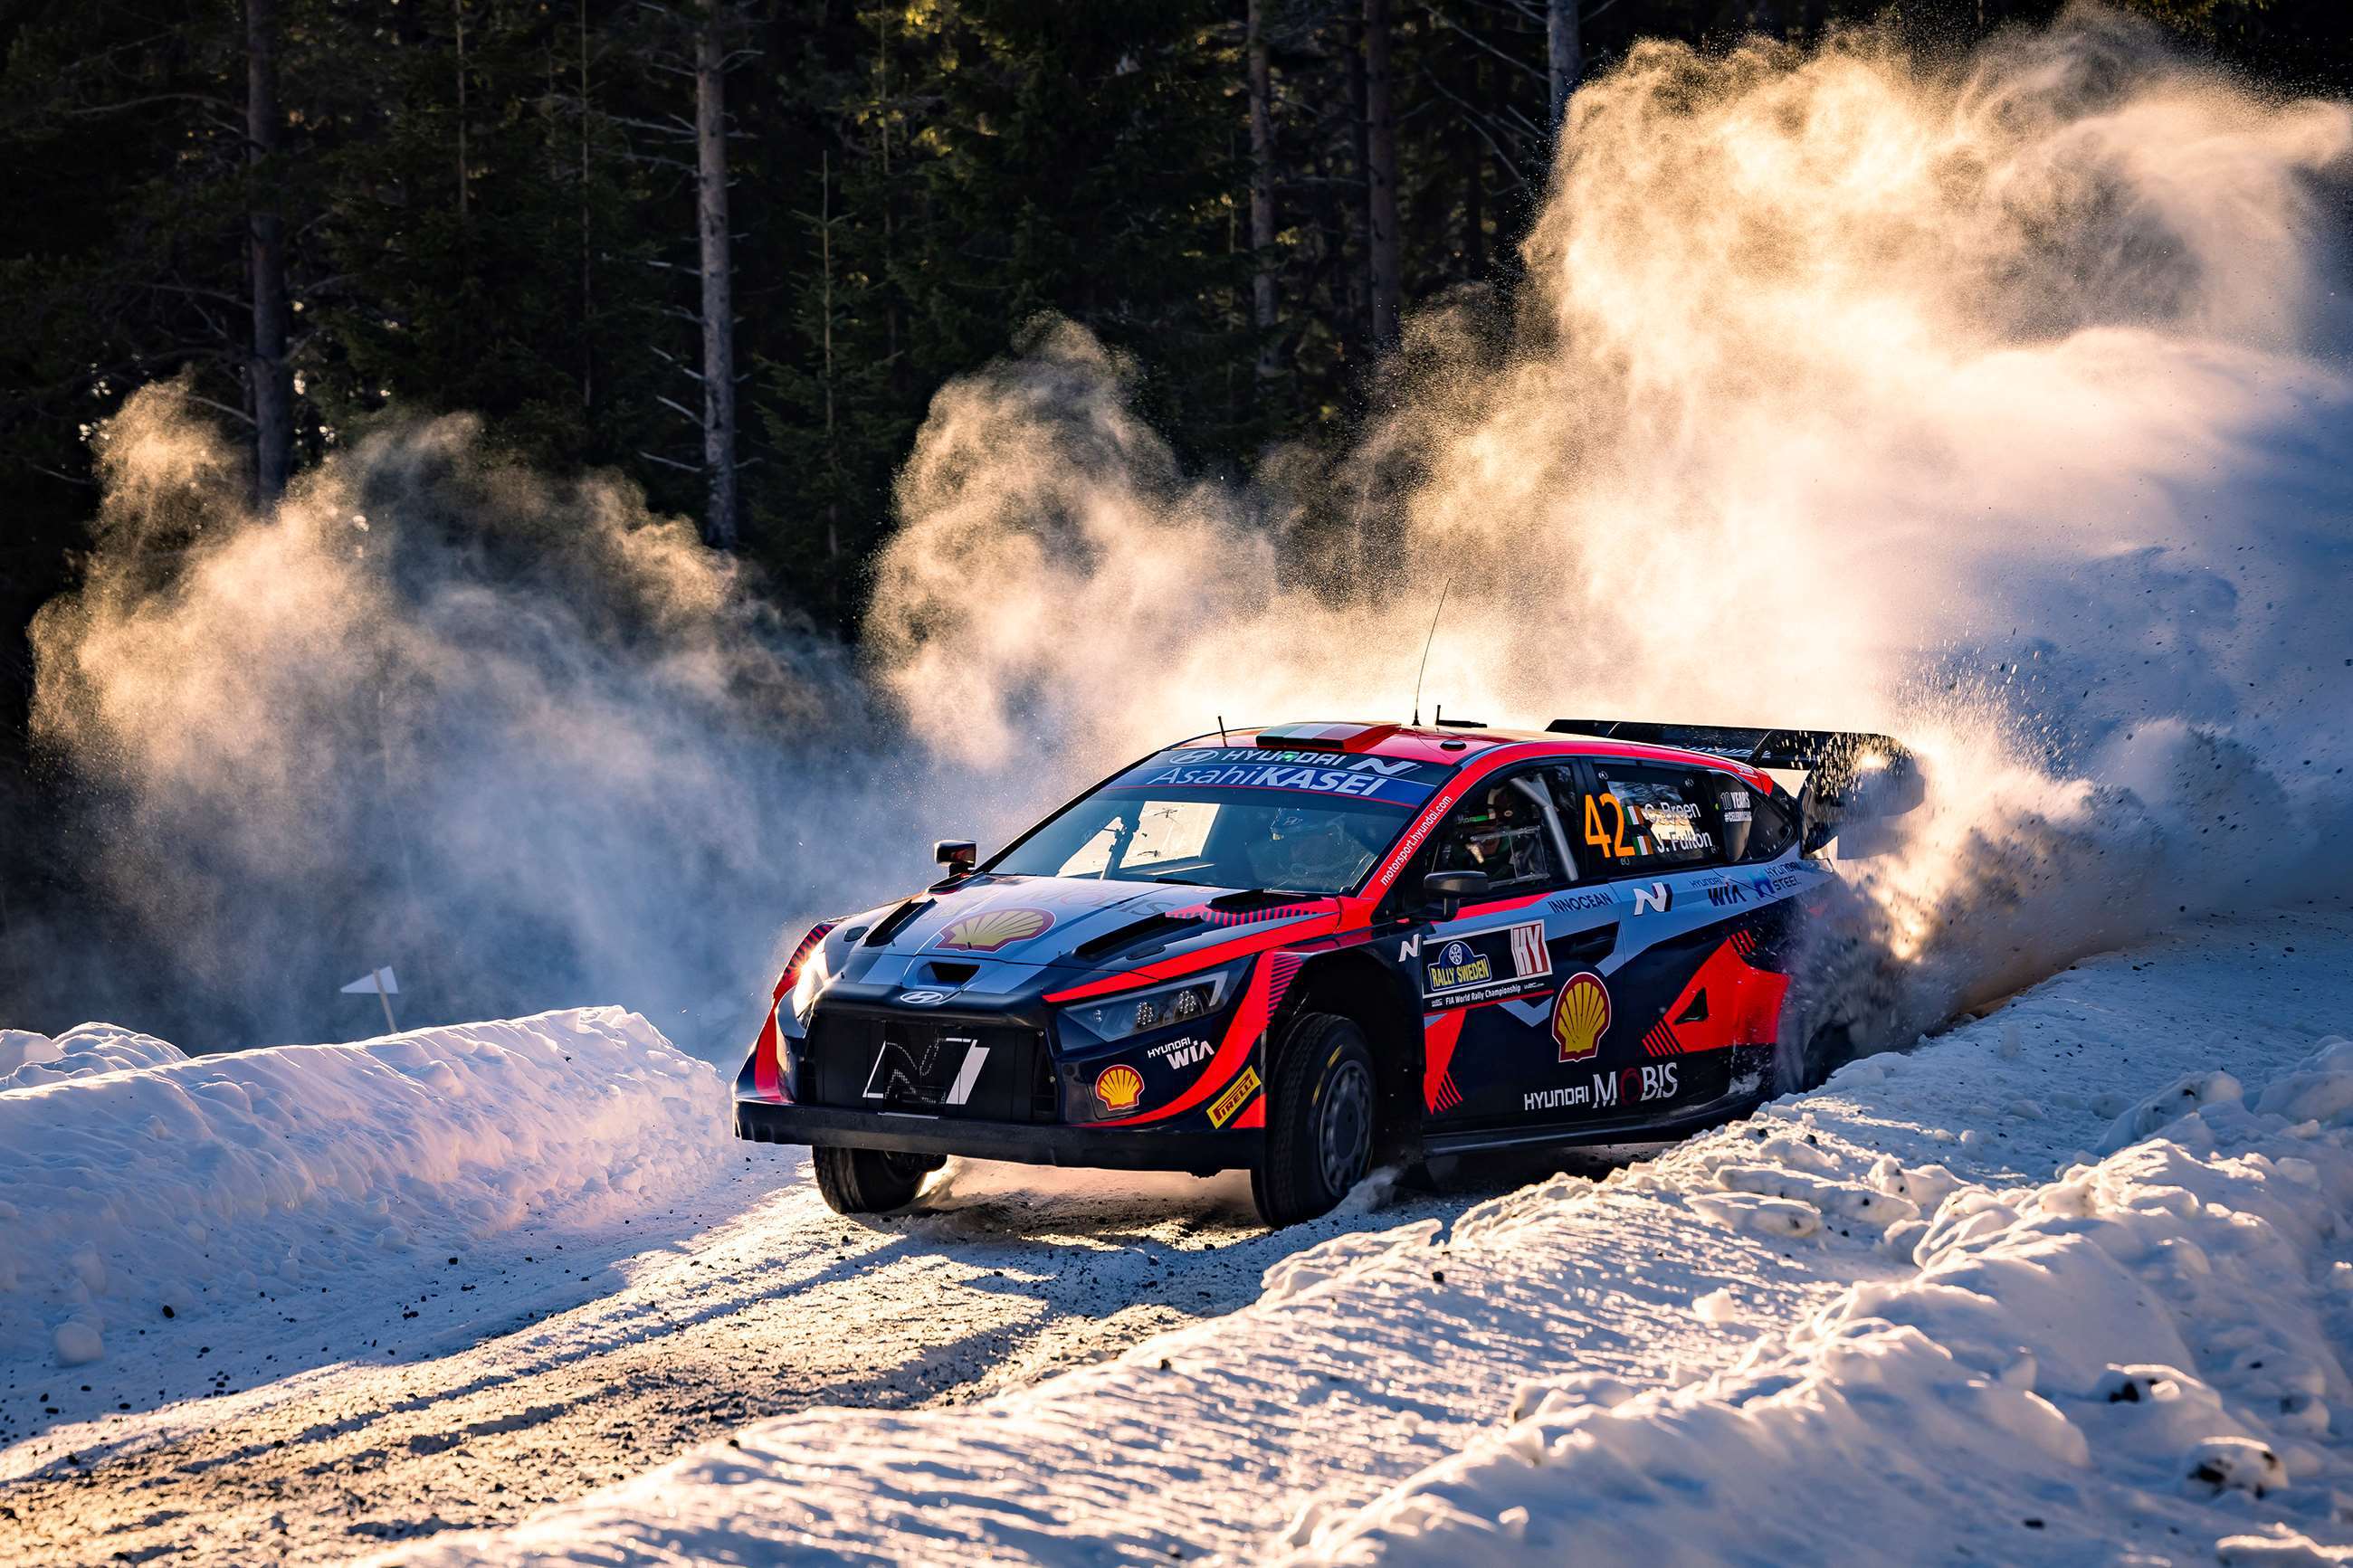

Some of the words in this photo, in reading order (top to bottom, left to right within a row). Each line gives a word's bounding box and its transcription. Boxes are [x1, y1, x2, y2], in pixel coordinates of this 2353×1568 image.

[1221, 750, 1348, 766] HYUNDAI
[1348, 756, 1423, 776] N
[1585, 793, 1635, 859] 42
[1660, 802, 1701, 822] Breen
[1380, 794, 1453, 887] motorsport.hyundai.com
[1669, 830, 1713, 851] Fulton
[1773, 875, 1802, 891] STEEL
[1548, 891, 1614, 914] INNOCEAN
[1633, 881, 1672, 917] N
[1398, 933, 1422, 963] N
[1431, 965, 1455, 988] RALLY
[1456, 958, 1490, 984] SWEDEN
[1445, 996, 1454, 1006] FIA
[1454, 994, 1471, 1004] World
[1471, 991, 1484, 1002] Rally
[1484, 984, 1521, 998] Championship
[1147, 1037, 1191, 1059] HYUNDAI
[1213, 1073, 1254, 1122] PIRELLI
[1524, 1085, 1589, 1111] HYUNDAI
[1592, 1061, 1678, 1109] MOBIS
